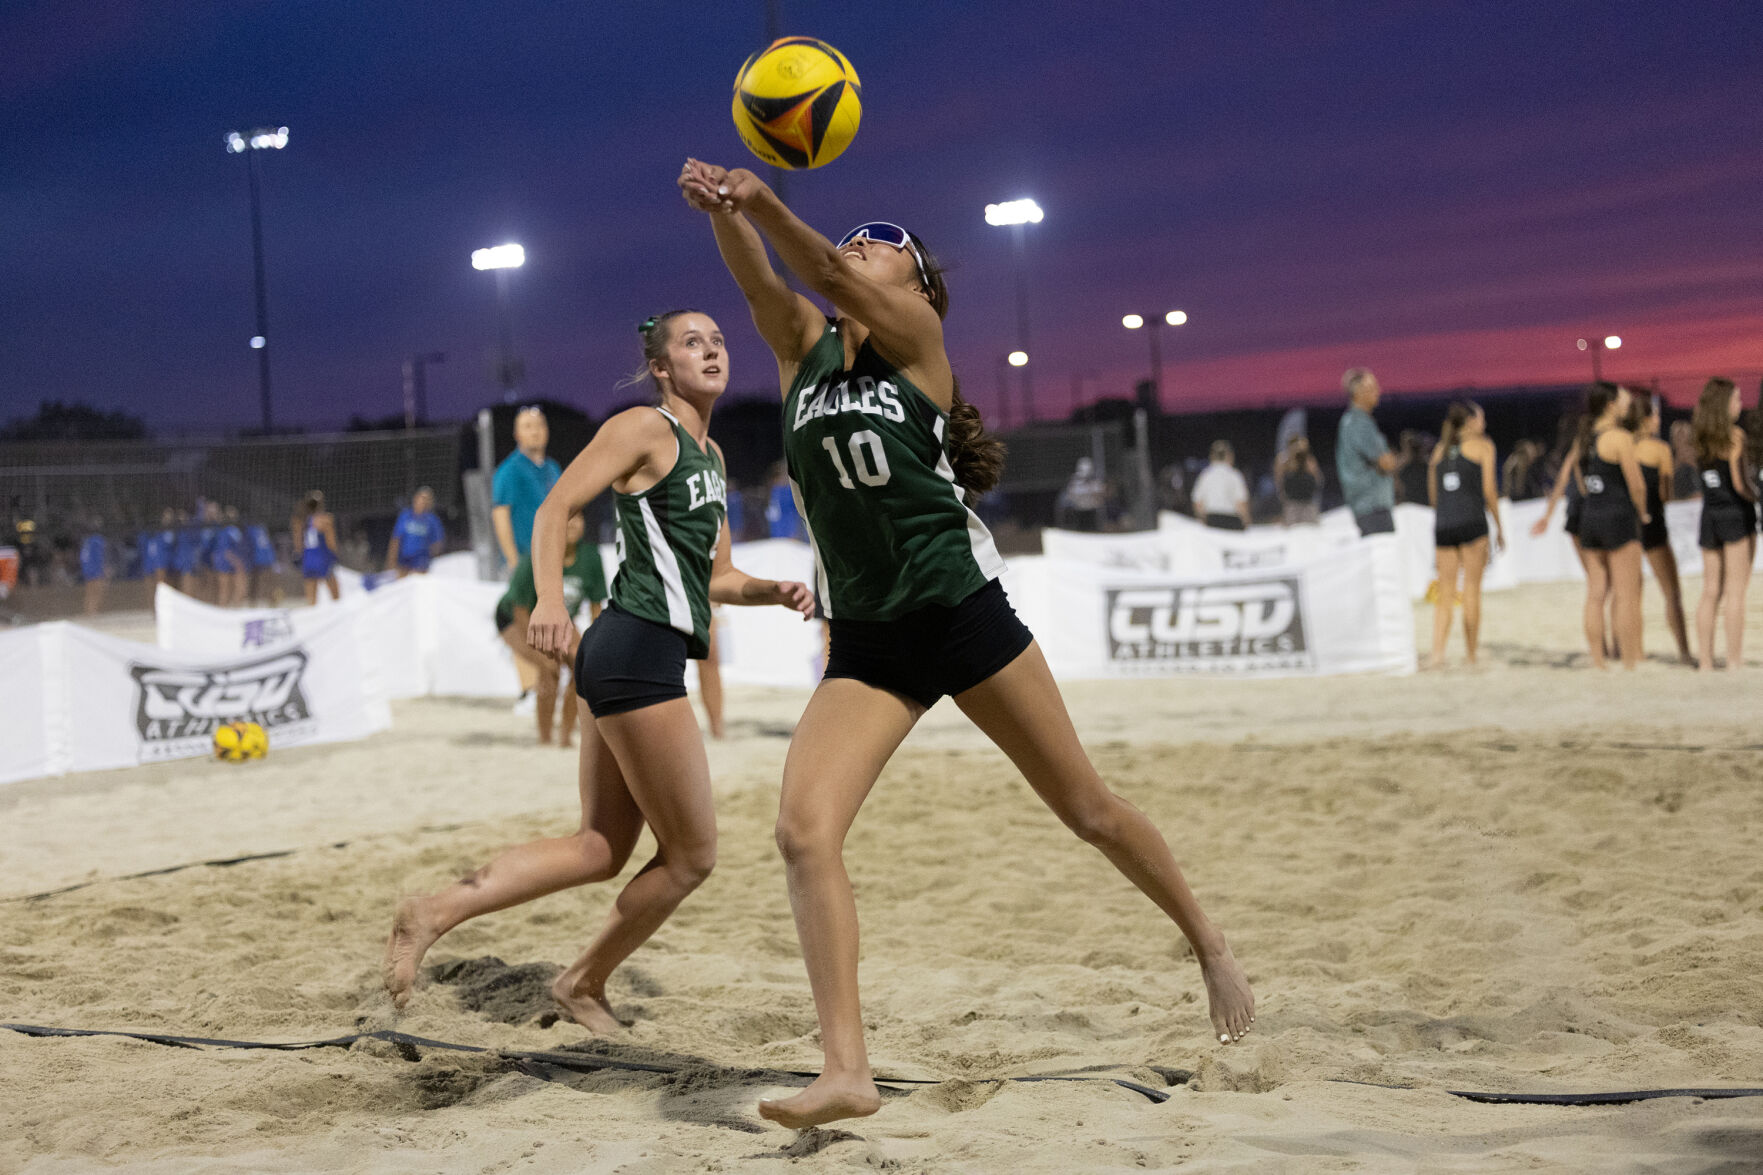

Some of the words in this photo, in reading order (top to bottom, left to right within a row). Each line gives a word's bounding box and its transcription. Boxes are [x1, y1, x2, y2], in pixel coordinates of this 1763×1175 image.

[793, 376, 905, 432] EAGLES
[821, 429, 892, 490] 10
[1112, 582, 1295, 644] CUSD
[1114, 634, 1296, 659] ATHLETICS
[143, 656, 301, 720] CUSD
[145, 702, 302, 739] ATHLTICS
